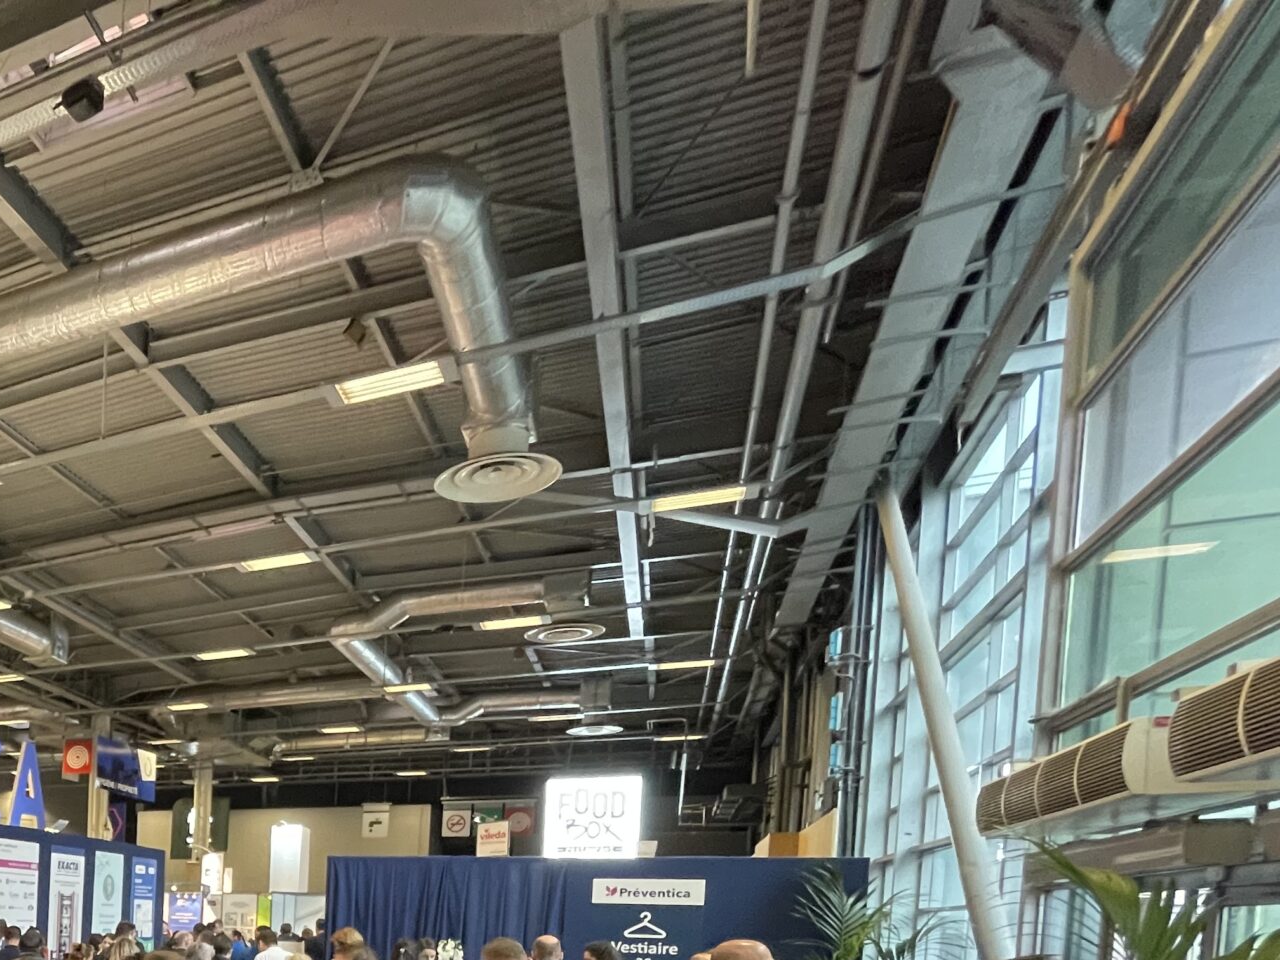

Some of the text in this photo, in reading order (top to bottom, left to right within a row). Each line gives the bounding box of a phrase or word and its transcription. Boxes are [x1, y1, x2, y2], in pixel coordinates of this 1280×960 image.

[558, 788, 626, 820] FOOD
[57, 860, 79, 871] EXACTA
[619, 888, 691, 899] Préventica
[611, 941, 678, 955] Vestiaire
